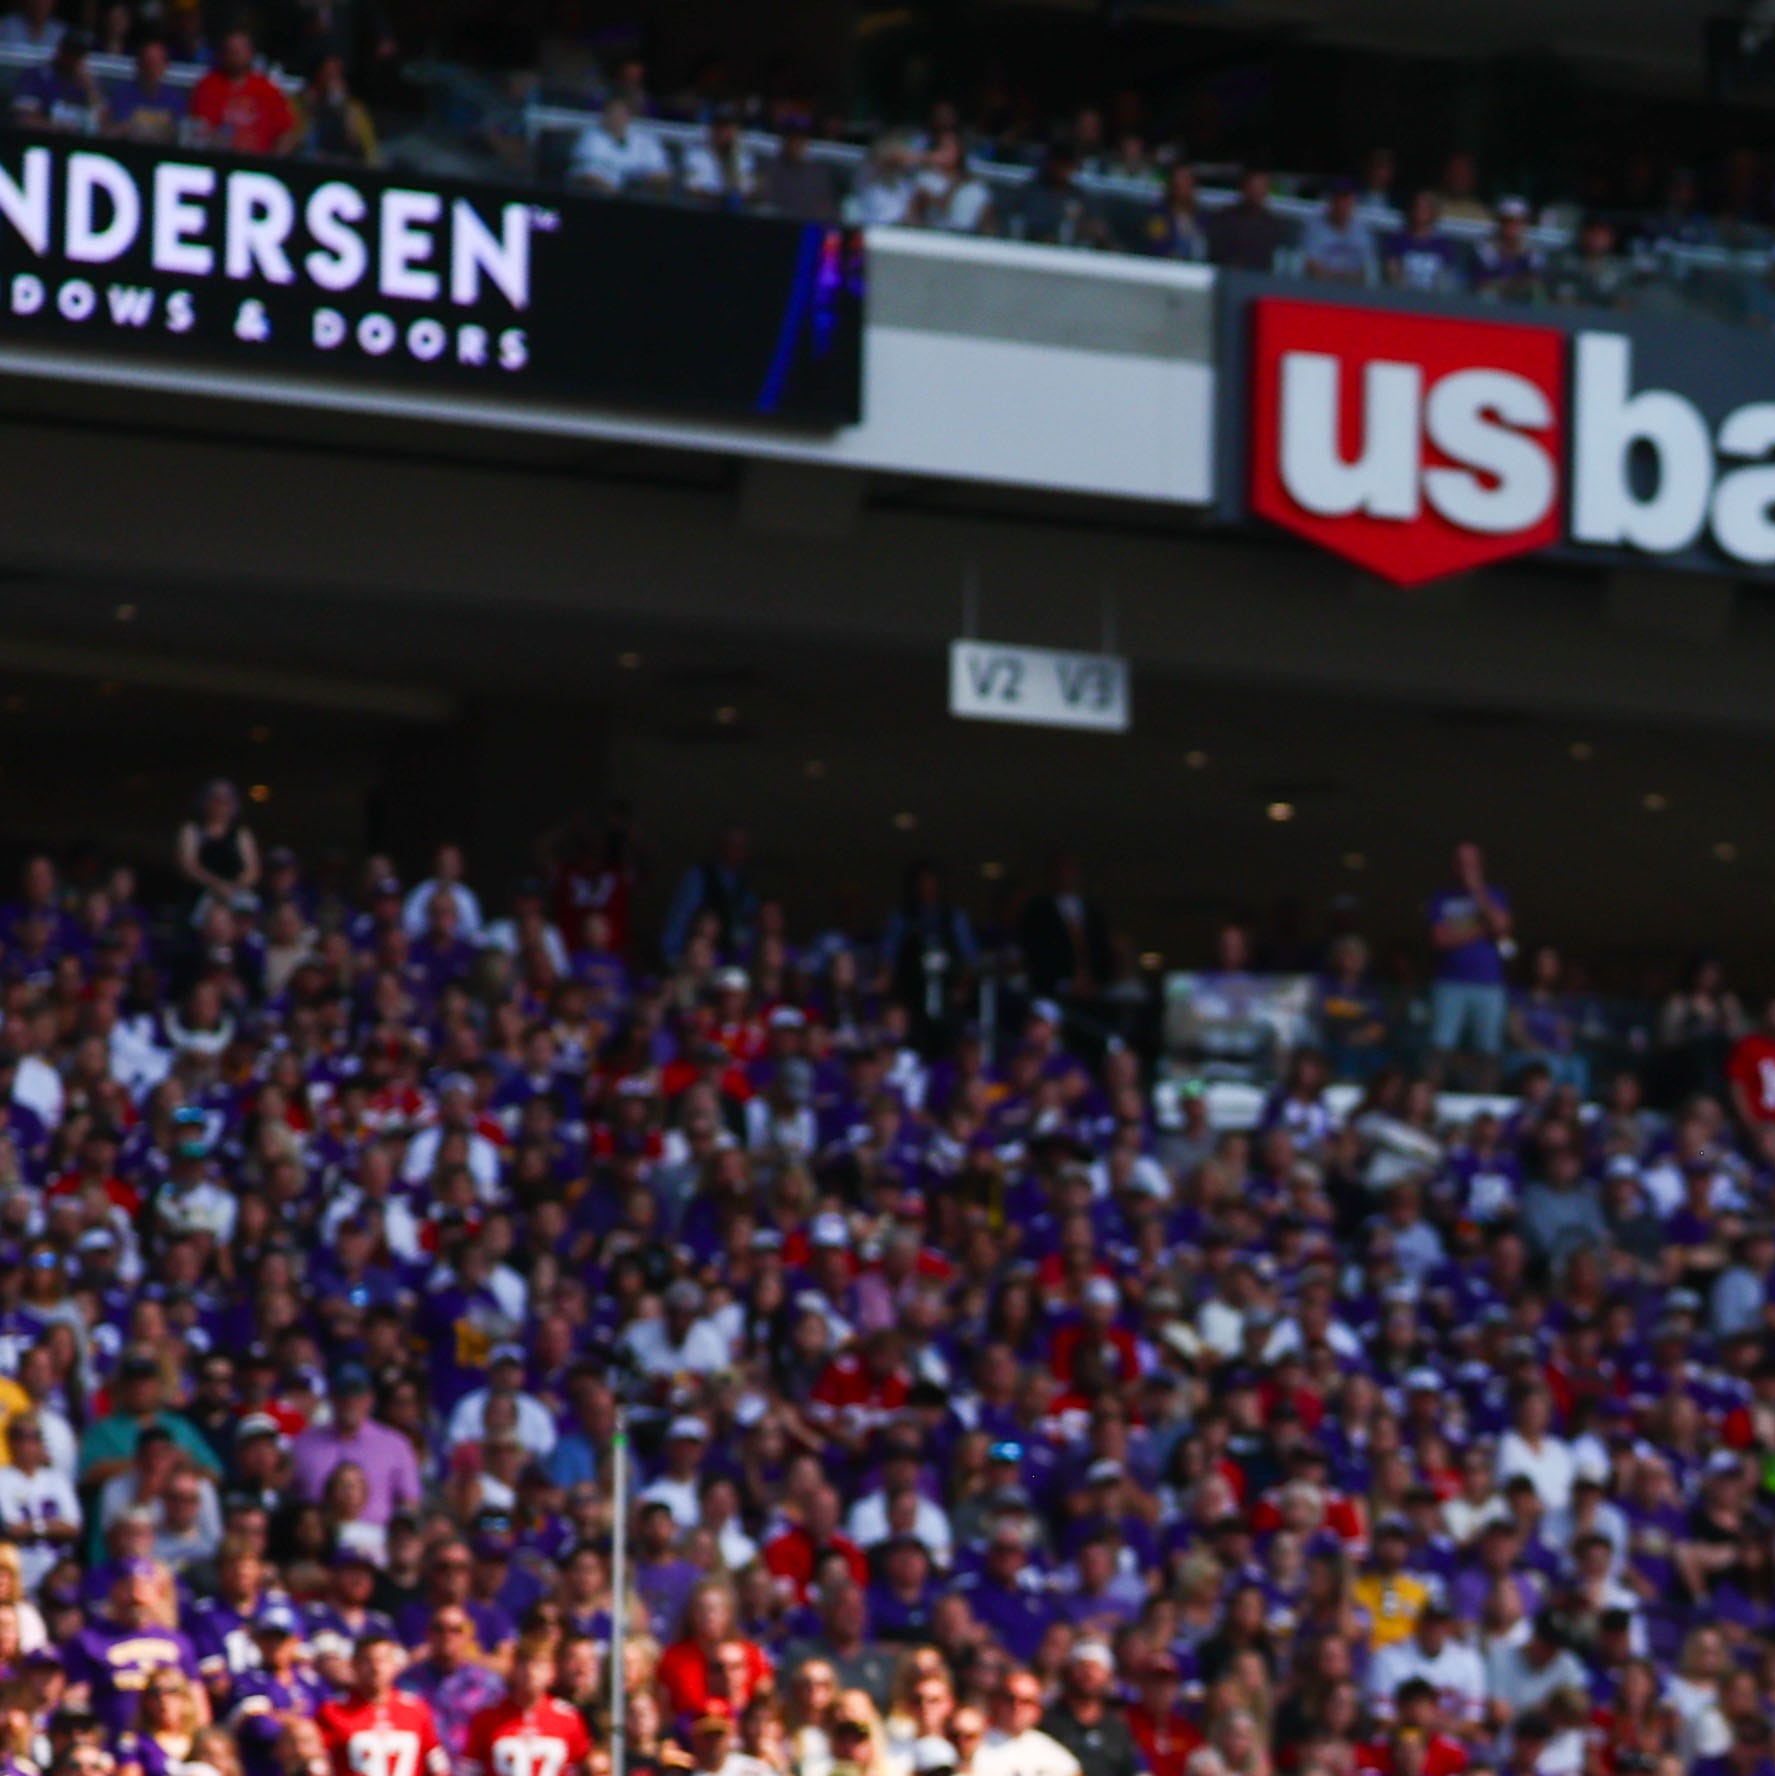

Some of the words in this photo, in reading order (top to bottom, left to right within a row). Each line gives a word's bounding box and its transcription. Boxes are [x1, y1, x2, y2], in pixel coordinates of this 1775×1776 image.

[11, 274, 195, 332] DOWS
[234, 300, 268, 341] &
[312, 308, 528, 370] DOORS
[967, 654, 1026, 702] V2
